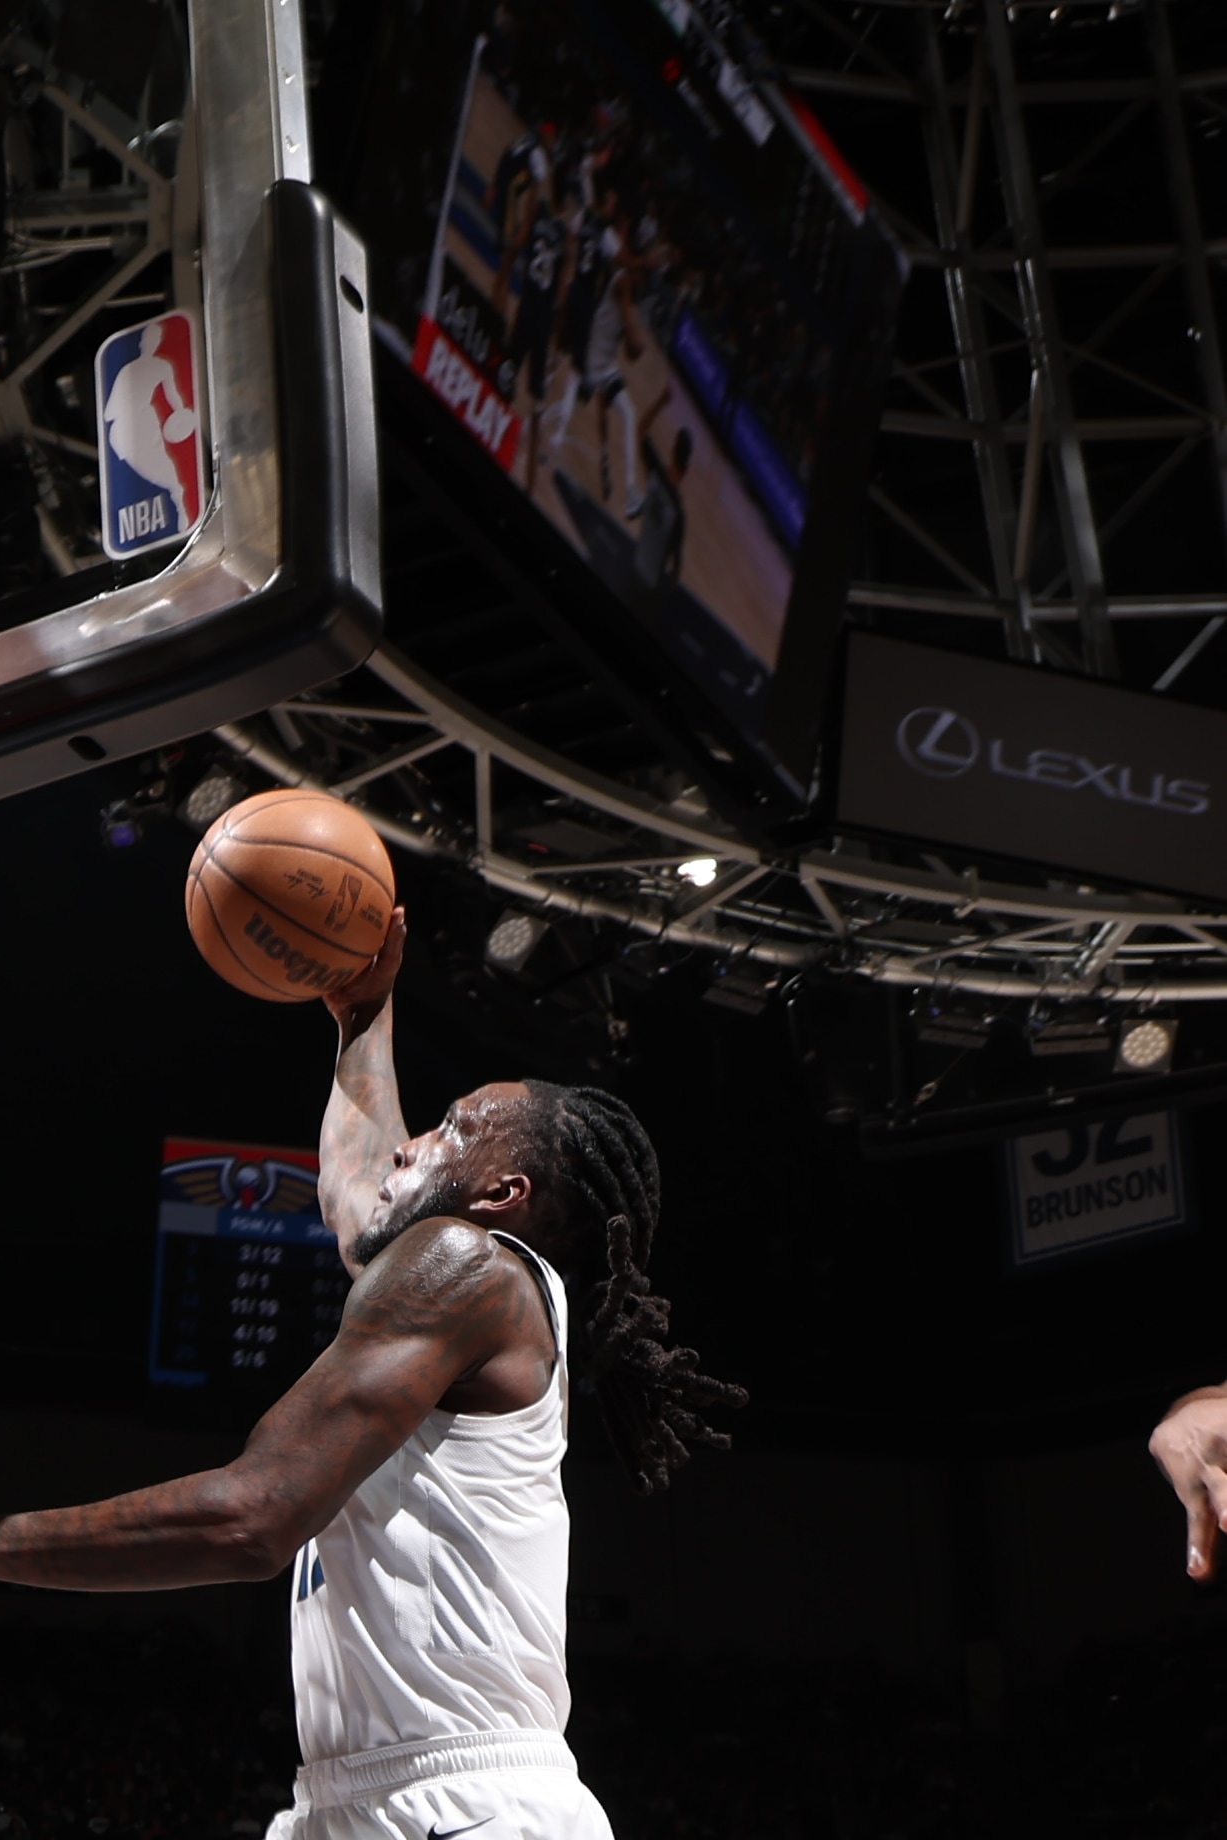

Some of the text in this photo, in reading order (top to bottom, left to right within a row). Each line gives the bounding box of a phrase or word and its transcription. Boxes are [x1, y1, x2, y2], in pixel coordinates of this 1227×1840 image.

[424, 335, 514, 454] REPLAY
[118, 494, 168, 545] NBA
[989, 739, 1210, 815] LEXUS
[1026, 1164, 1168, 1229] BRUNSON
